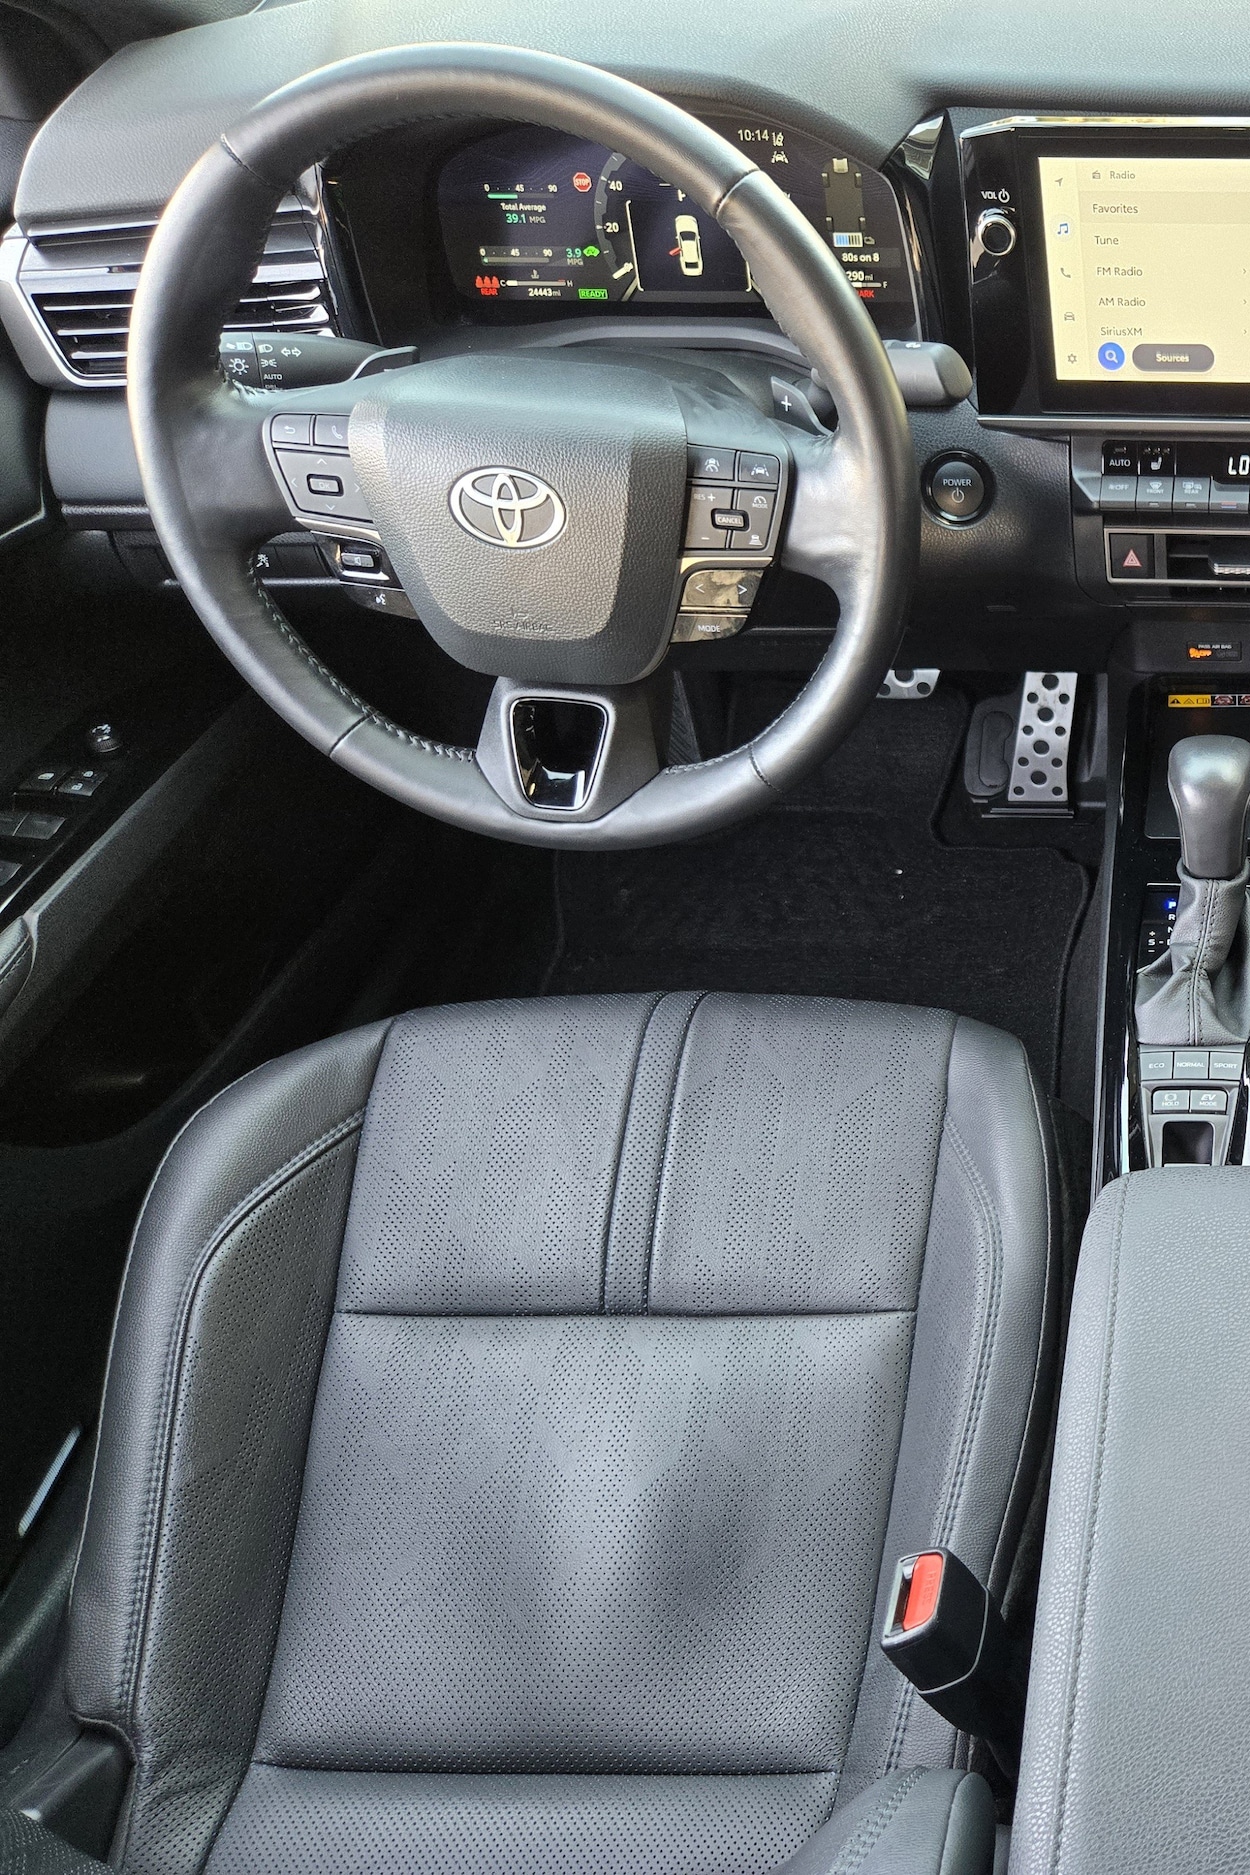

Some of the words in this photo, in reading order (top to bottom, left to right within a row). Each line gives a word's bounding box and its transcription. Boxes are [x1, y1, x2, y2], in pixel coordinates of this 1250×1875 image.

[738, 129, 769, 141] 10:14
[1109, 170, 1136, 180] Radio
[575, 178, 590, 187] STOP
[609, 181, 623, 191] 40
[515, 184, 525, 192] 45
[548, 184, 557, 192] 90
[981, 191, 997, 199] VOL
[500, 203, 518, 211] Total
[519, 203, 546, 212] Average
[1092, 204, 1138, 214] Favorites
[506, 213, 526, 223] 39.1
[529, 216, 546, 224] MPG
[606, 222, 619, 233] 20
[1095, 235, 1119, 245] Tune
[511, 248, 520, 256] 45
[543, 249, 552, 257] 90
[566, 248, 582, 258] 3.9
[842, 253, 859, 262] 80s
[872, 253, 880, 262] 8
[1096, 267, 1112, 276] FM
[1113, 267, 1143, 277] Radio
[528, 288, 552, 297] 24443
[581, 290, 605, 298] READY
[858, 290, 875, 298] ARK
[1098, 297, 1115, 307] AM
[1117, 297, 1146, 307] Radio
[1100, 327, 1143, 337] SiriusXM
[1155, 353, 1190, 363] Sources
[1109, 459, 1131, 467] AUTO
[942, 479, 972, 487] POWER
[717, 516, 742, 525] CANCEL
[698, 625, 721, 633] MODE
[1168, 901, 1177, 909] P
